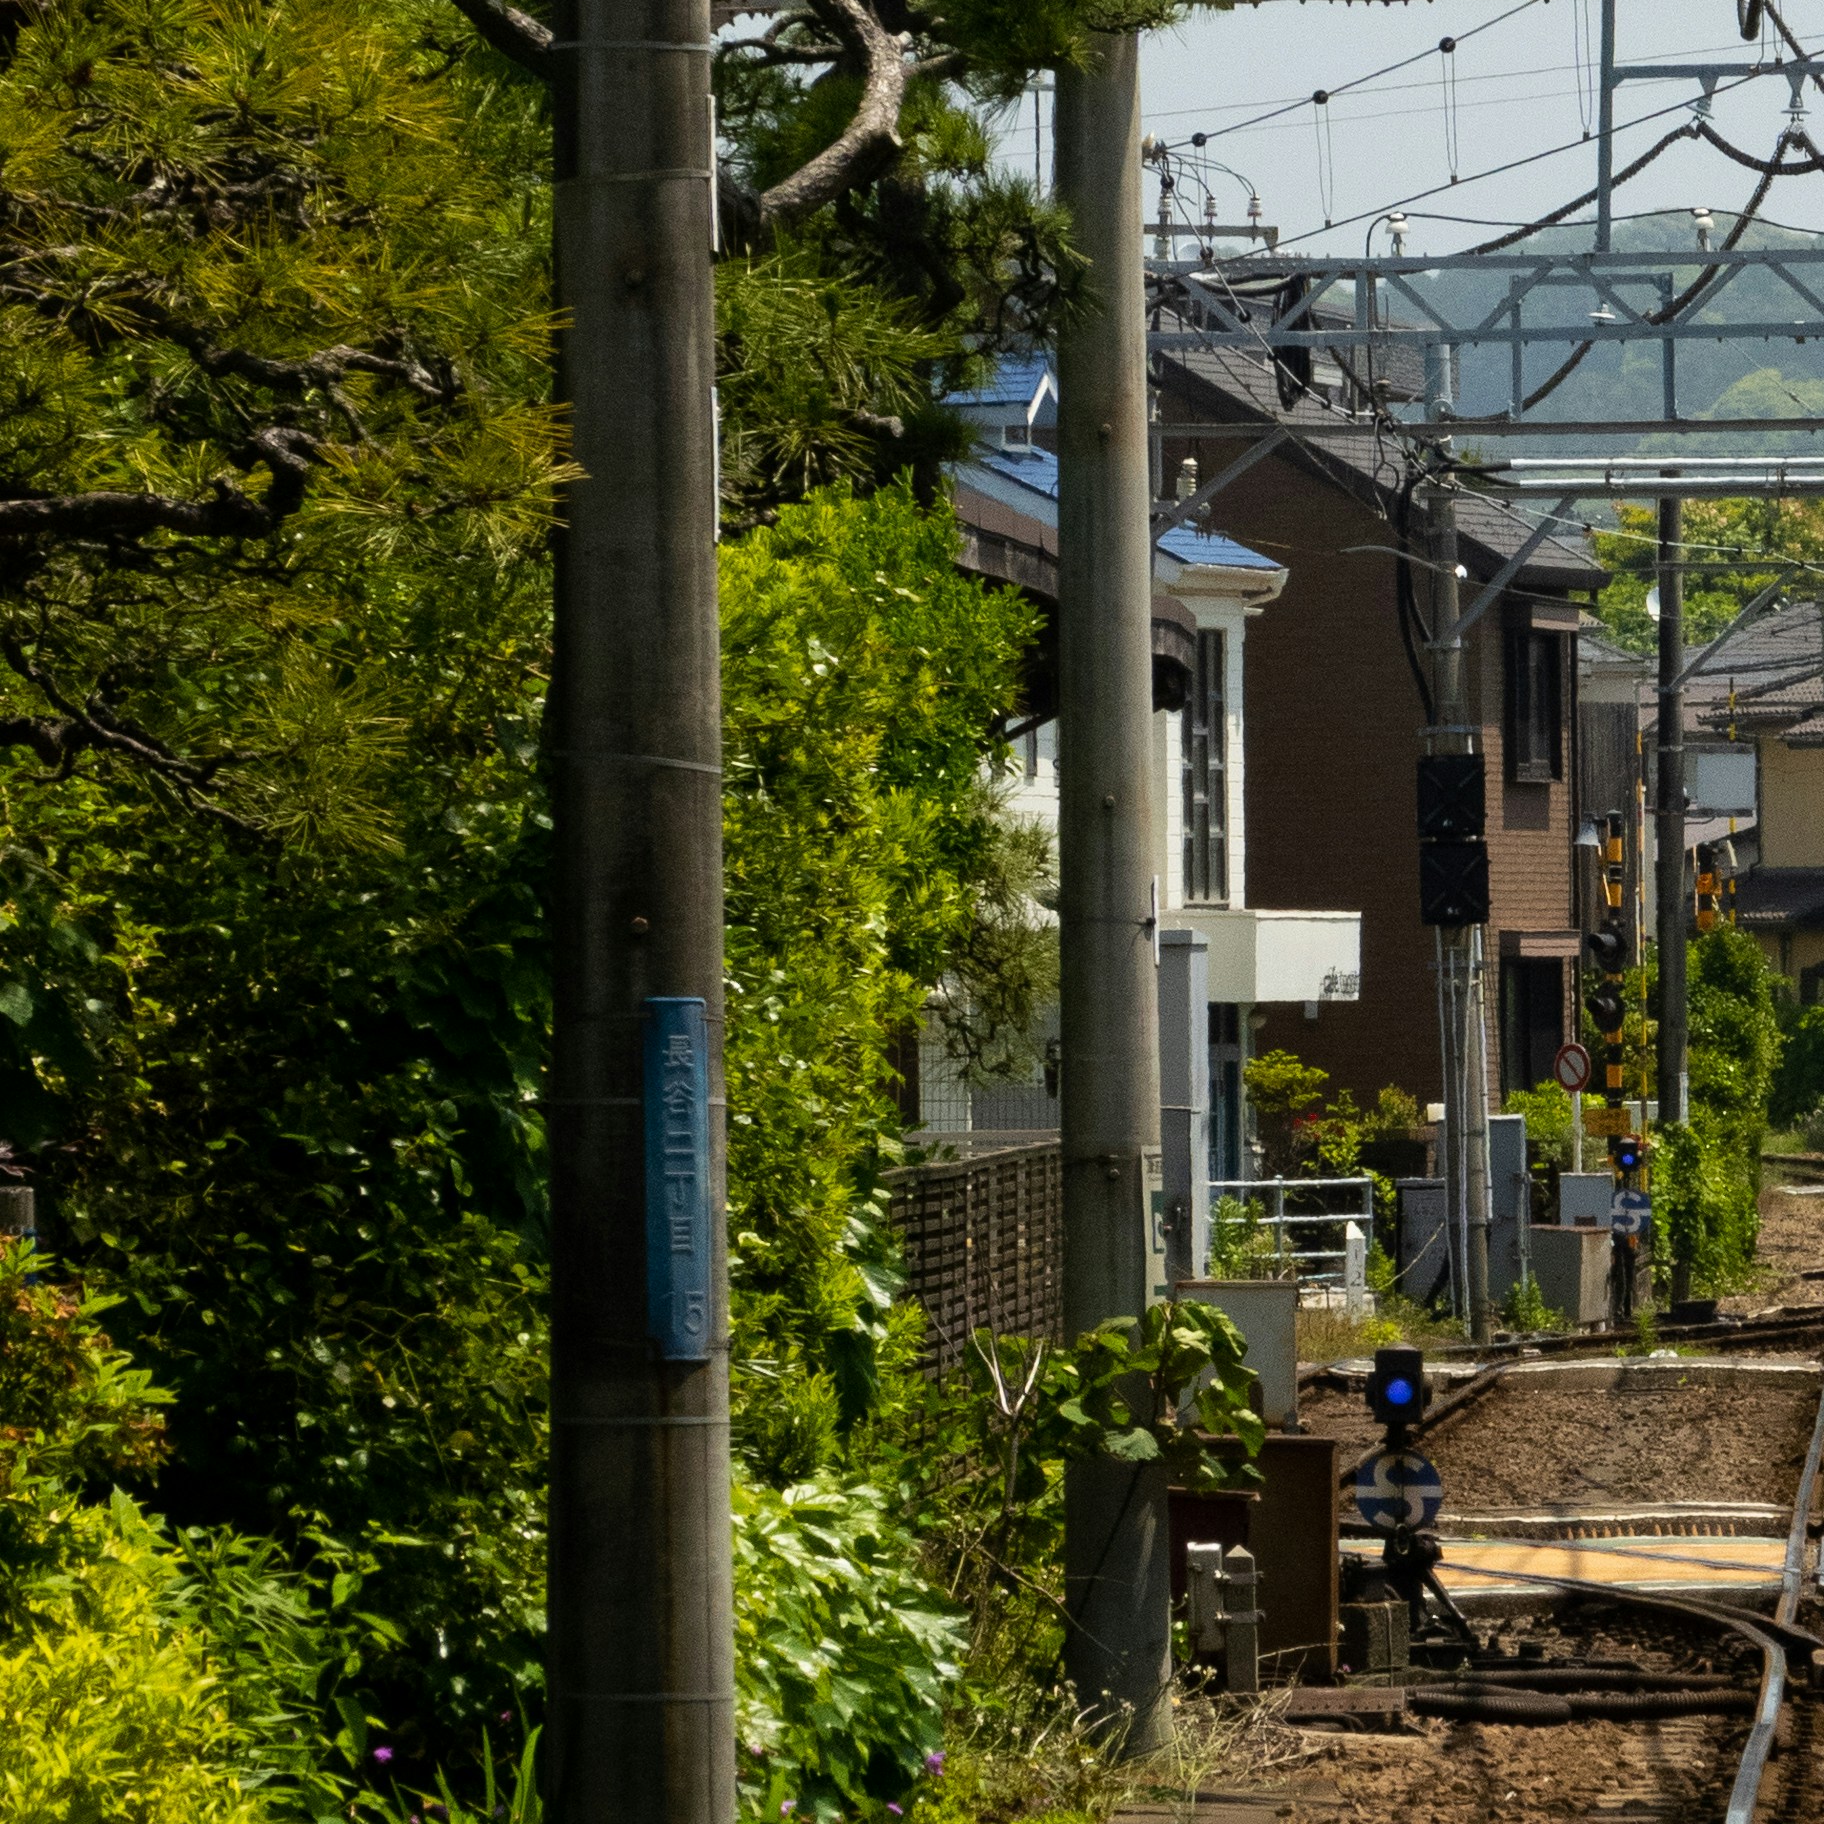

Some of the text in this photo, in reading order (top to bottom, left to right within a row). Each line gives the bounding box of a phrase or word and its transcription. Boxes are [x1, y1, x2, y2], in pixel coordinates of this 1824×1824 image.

[662, 1034, 696, 1254] 長谷二丁目
